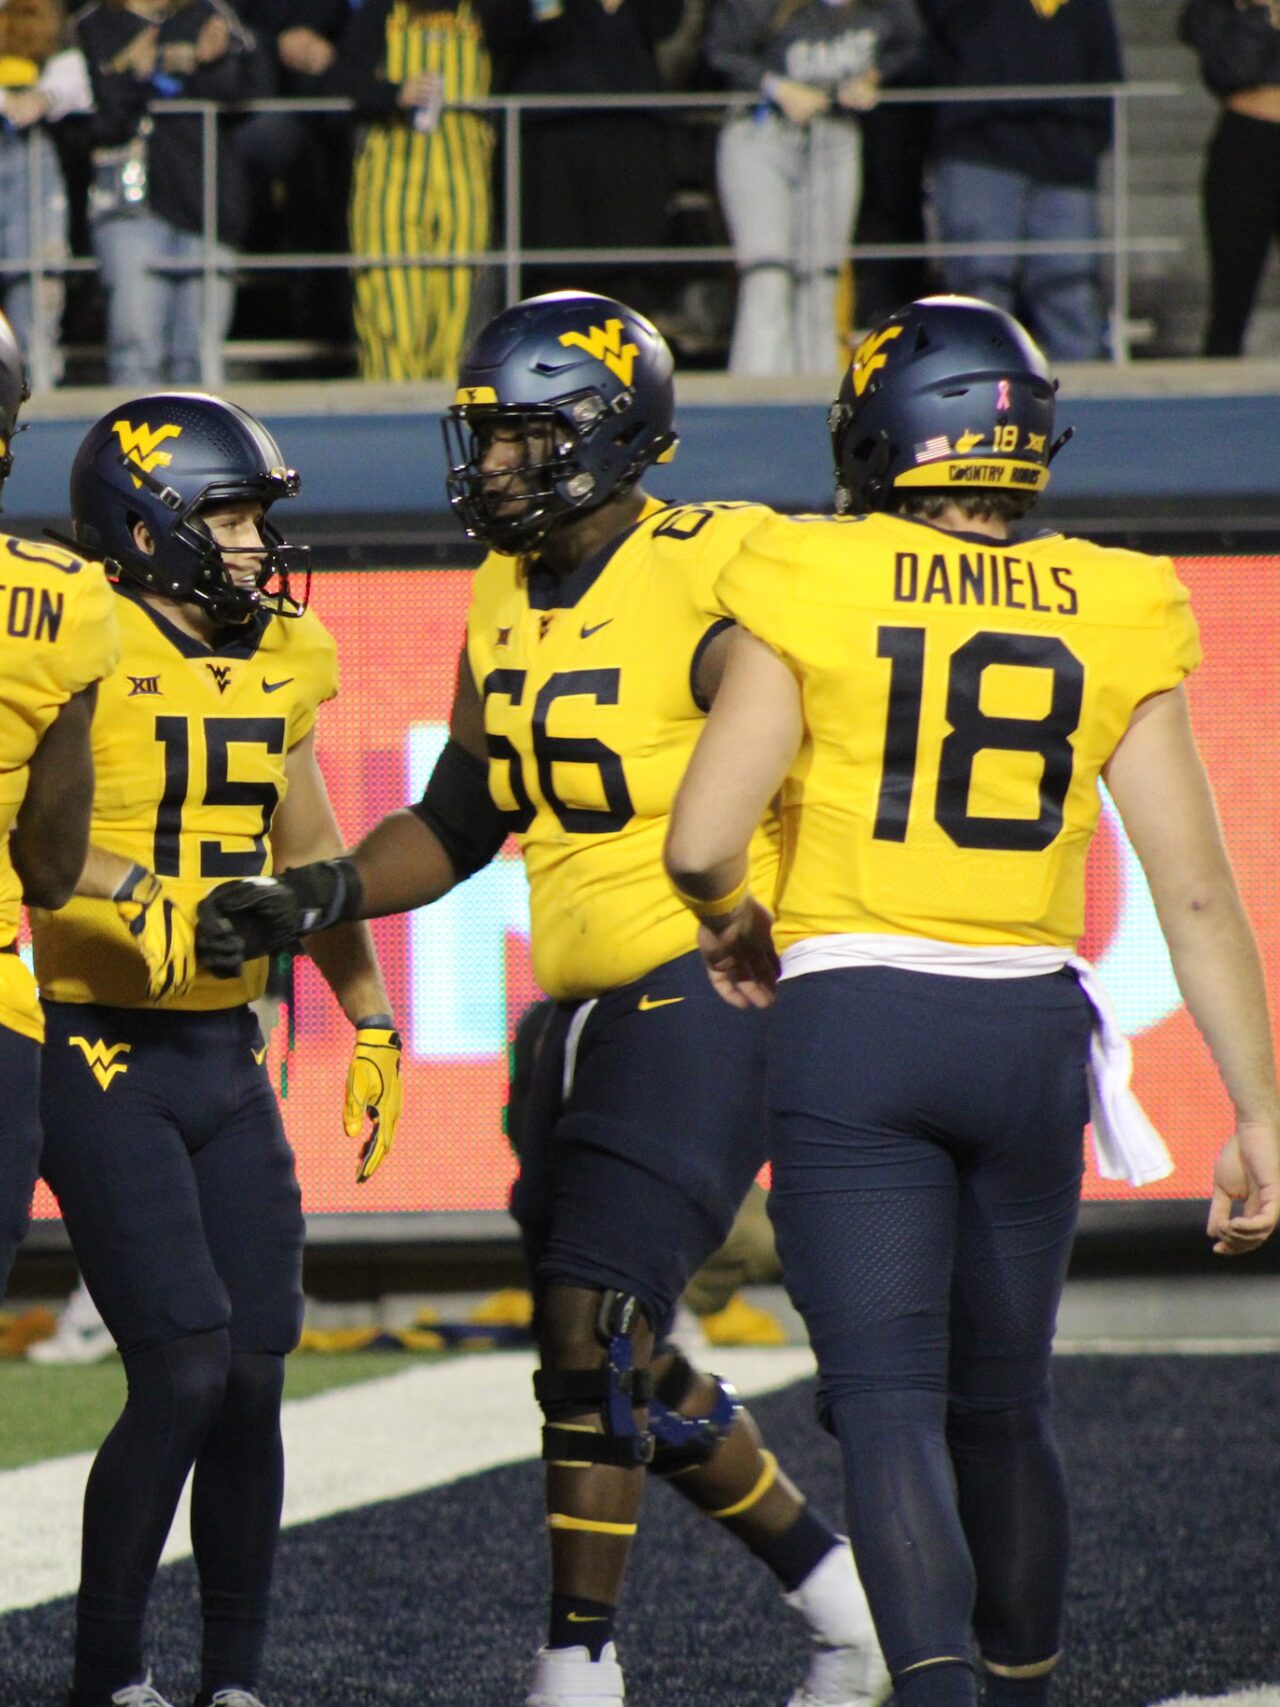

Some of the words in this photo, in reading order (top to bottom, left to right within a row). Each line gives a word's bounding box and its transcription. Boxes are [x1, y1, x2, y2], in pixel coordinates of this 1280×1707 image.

[992, 425, 1019, 453] 18
[893, 551, 1078, 616] DANIELS
[153, 716, 286, 878] 15
[484, 667, 636, 833] 66
[872, 625, 1085, 852] 18
